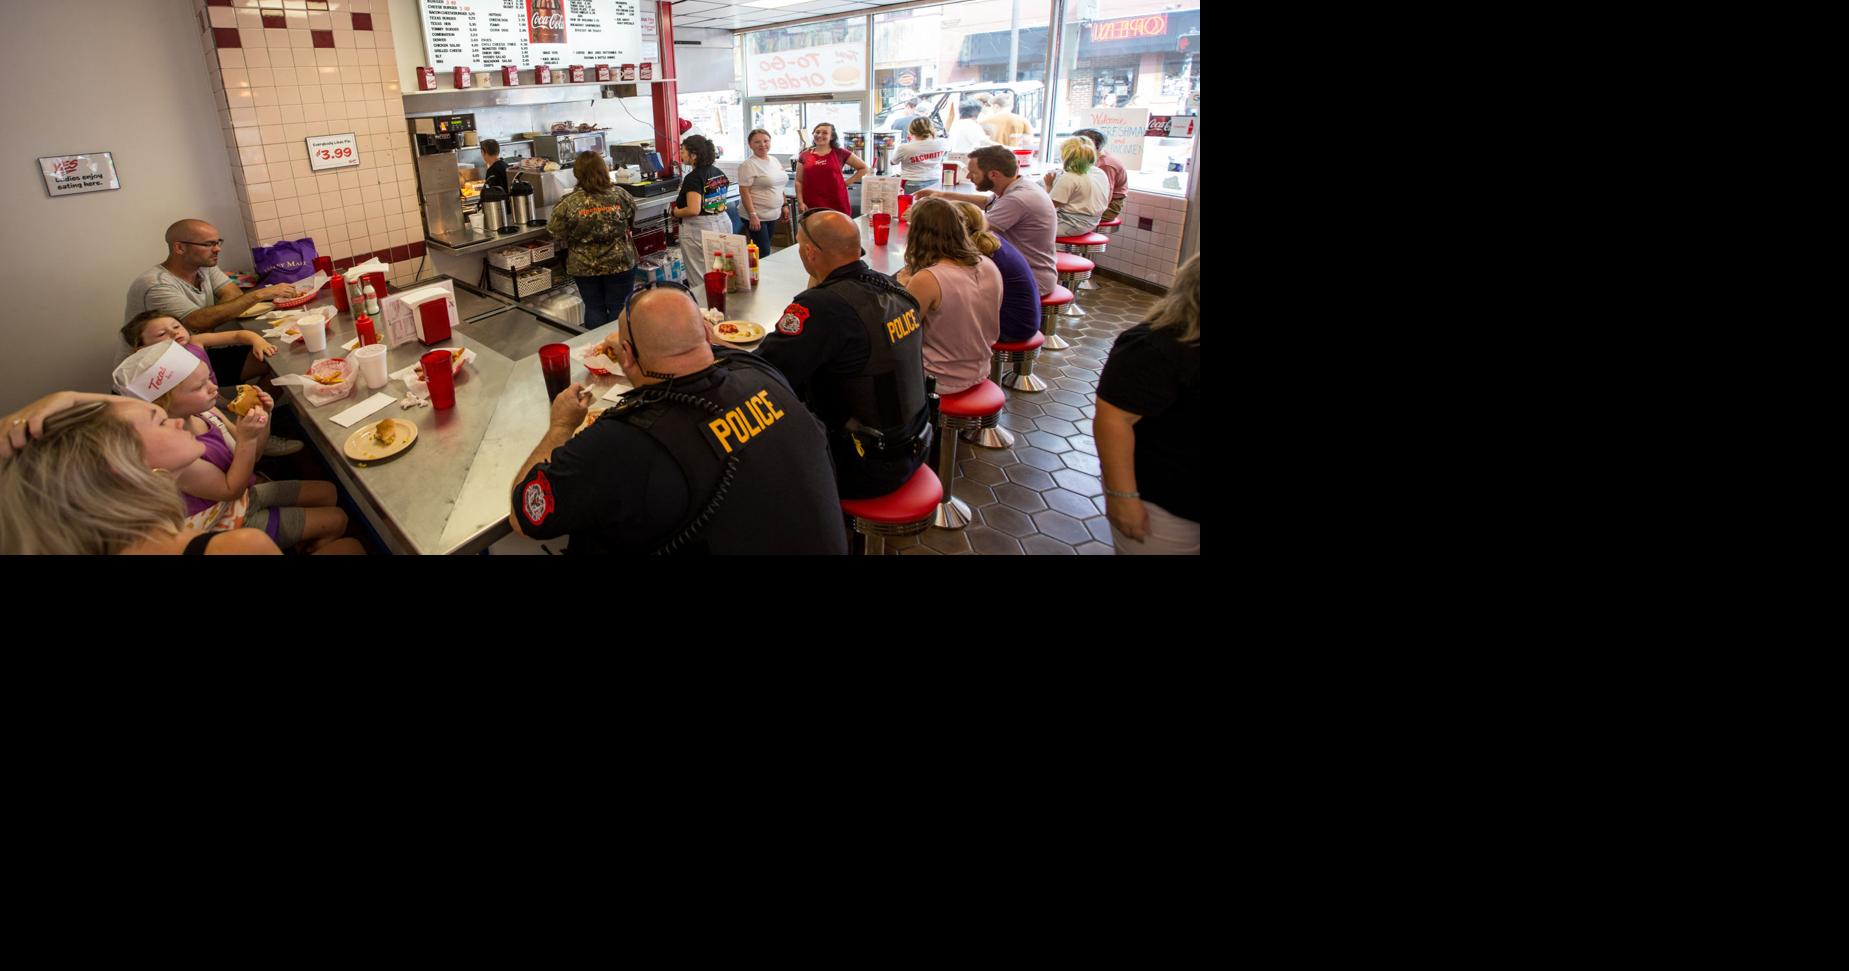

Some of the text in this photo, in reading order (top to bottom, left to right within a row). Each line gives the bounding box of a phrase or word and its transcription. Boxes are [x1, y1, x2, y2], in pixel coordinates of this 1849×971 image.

[910, 150, 945, 164] SECURITY
[58, 182, 82, 190] eating
[886, 308, 920, 344] POLICE
[708, 389, 785, 453] POLICE
